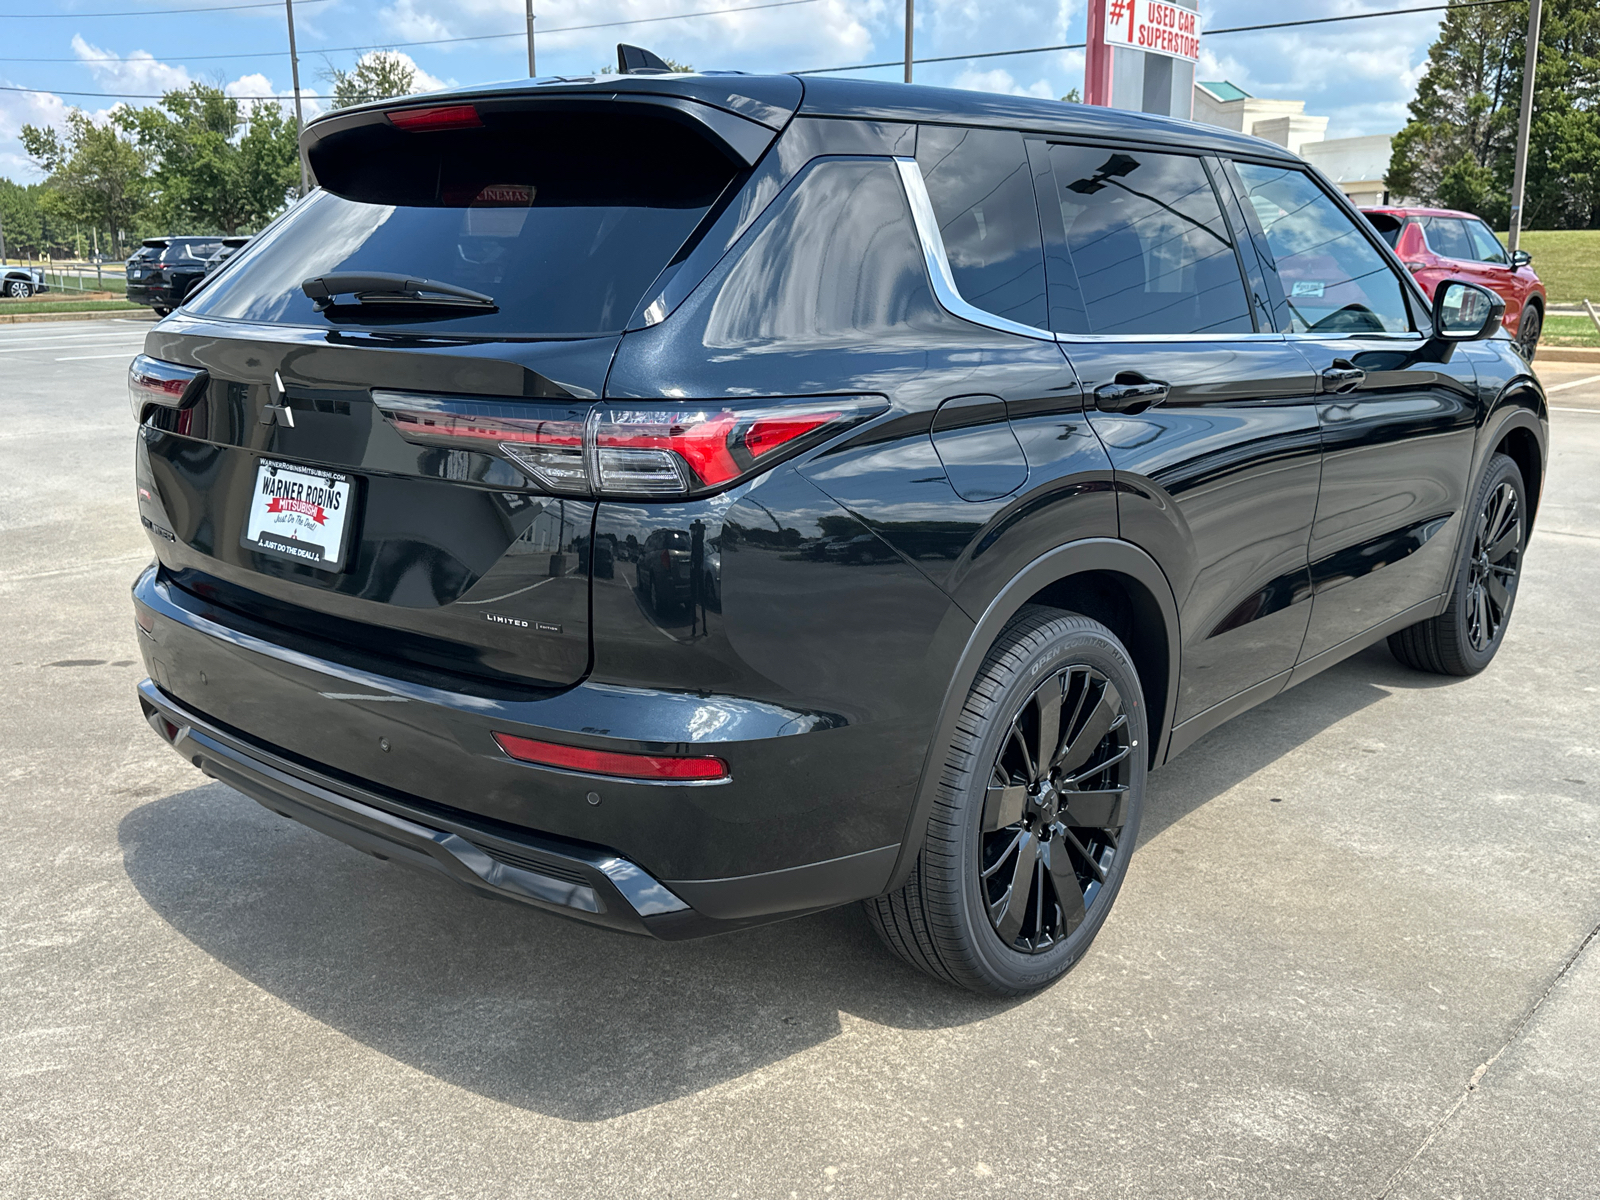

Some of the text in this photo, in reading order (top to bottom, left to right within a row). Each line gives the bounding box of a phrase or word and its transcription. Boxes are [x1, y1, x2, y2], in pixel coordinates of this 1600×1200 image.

[1109, 0, 1135, 43] #1
[1148, 2, 1195, 35] USED CAR
[1138, 24, 1200, 59] SUPERSTORE
[262, 476, 341, 510] WARNER ROBINS
[278, 499, 318, 517] MITSUBISHI
[264, 540, 277, 550] JUST
[286, 545, 297, 555] THE
[297, 549, 315, 559] DEAL!
[487, 614, 529, 627] LIMITED
[1031, 646, 1061, 675] OPEN
[1064, 636, 1108, 650] COUNTRY
